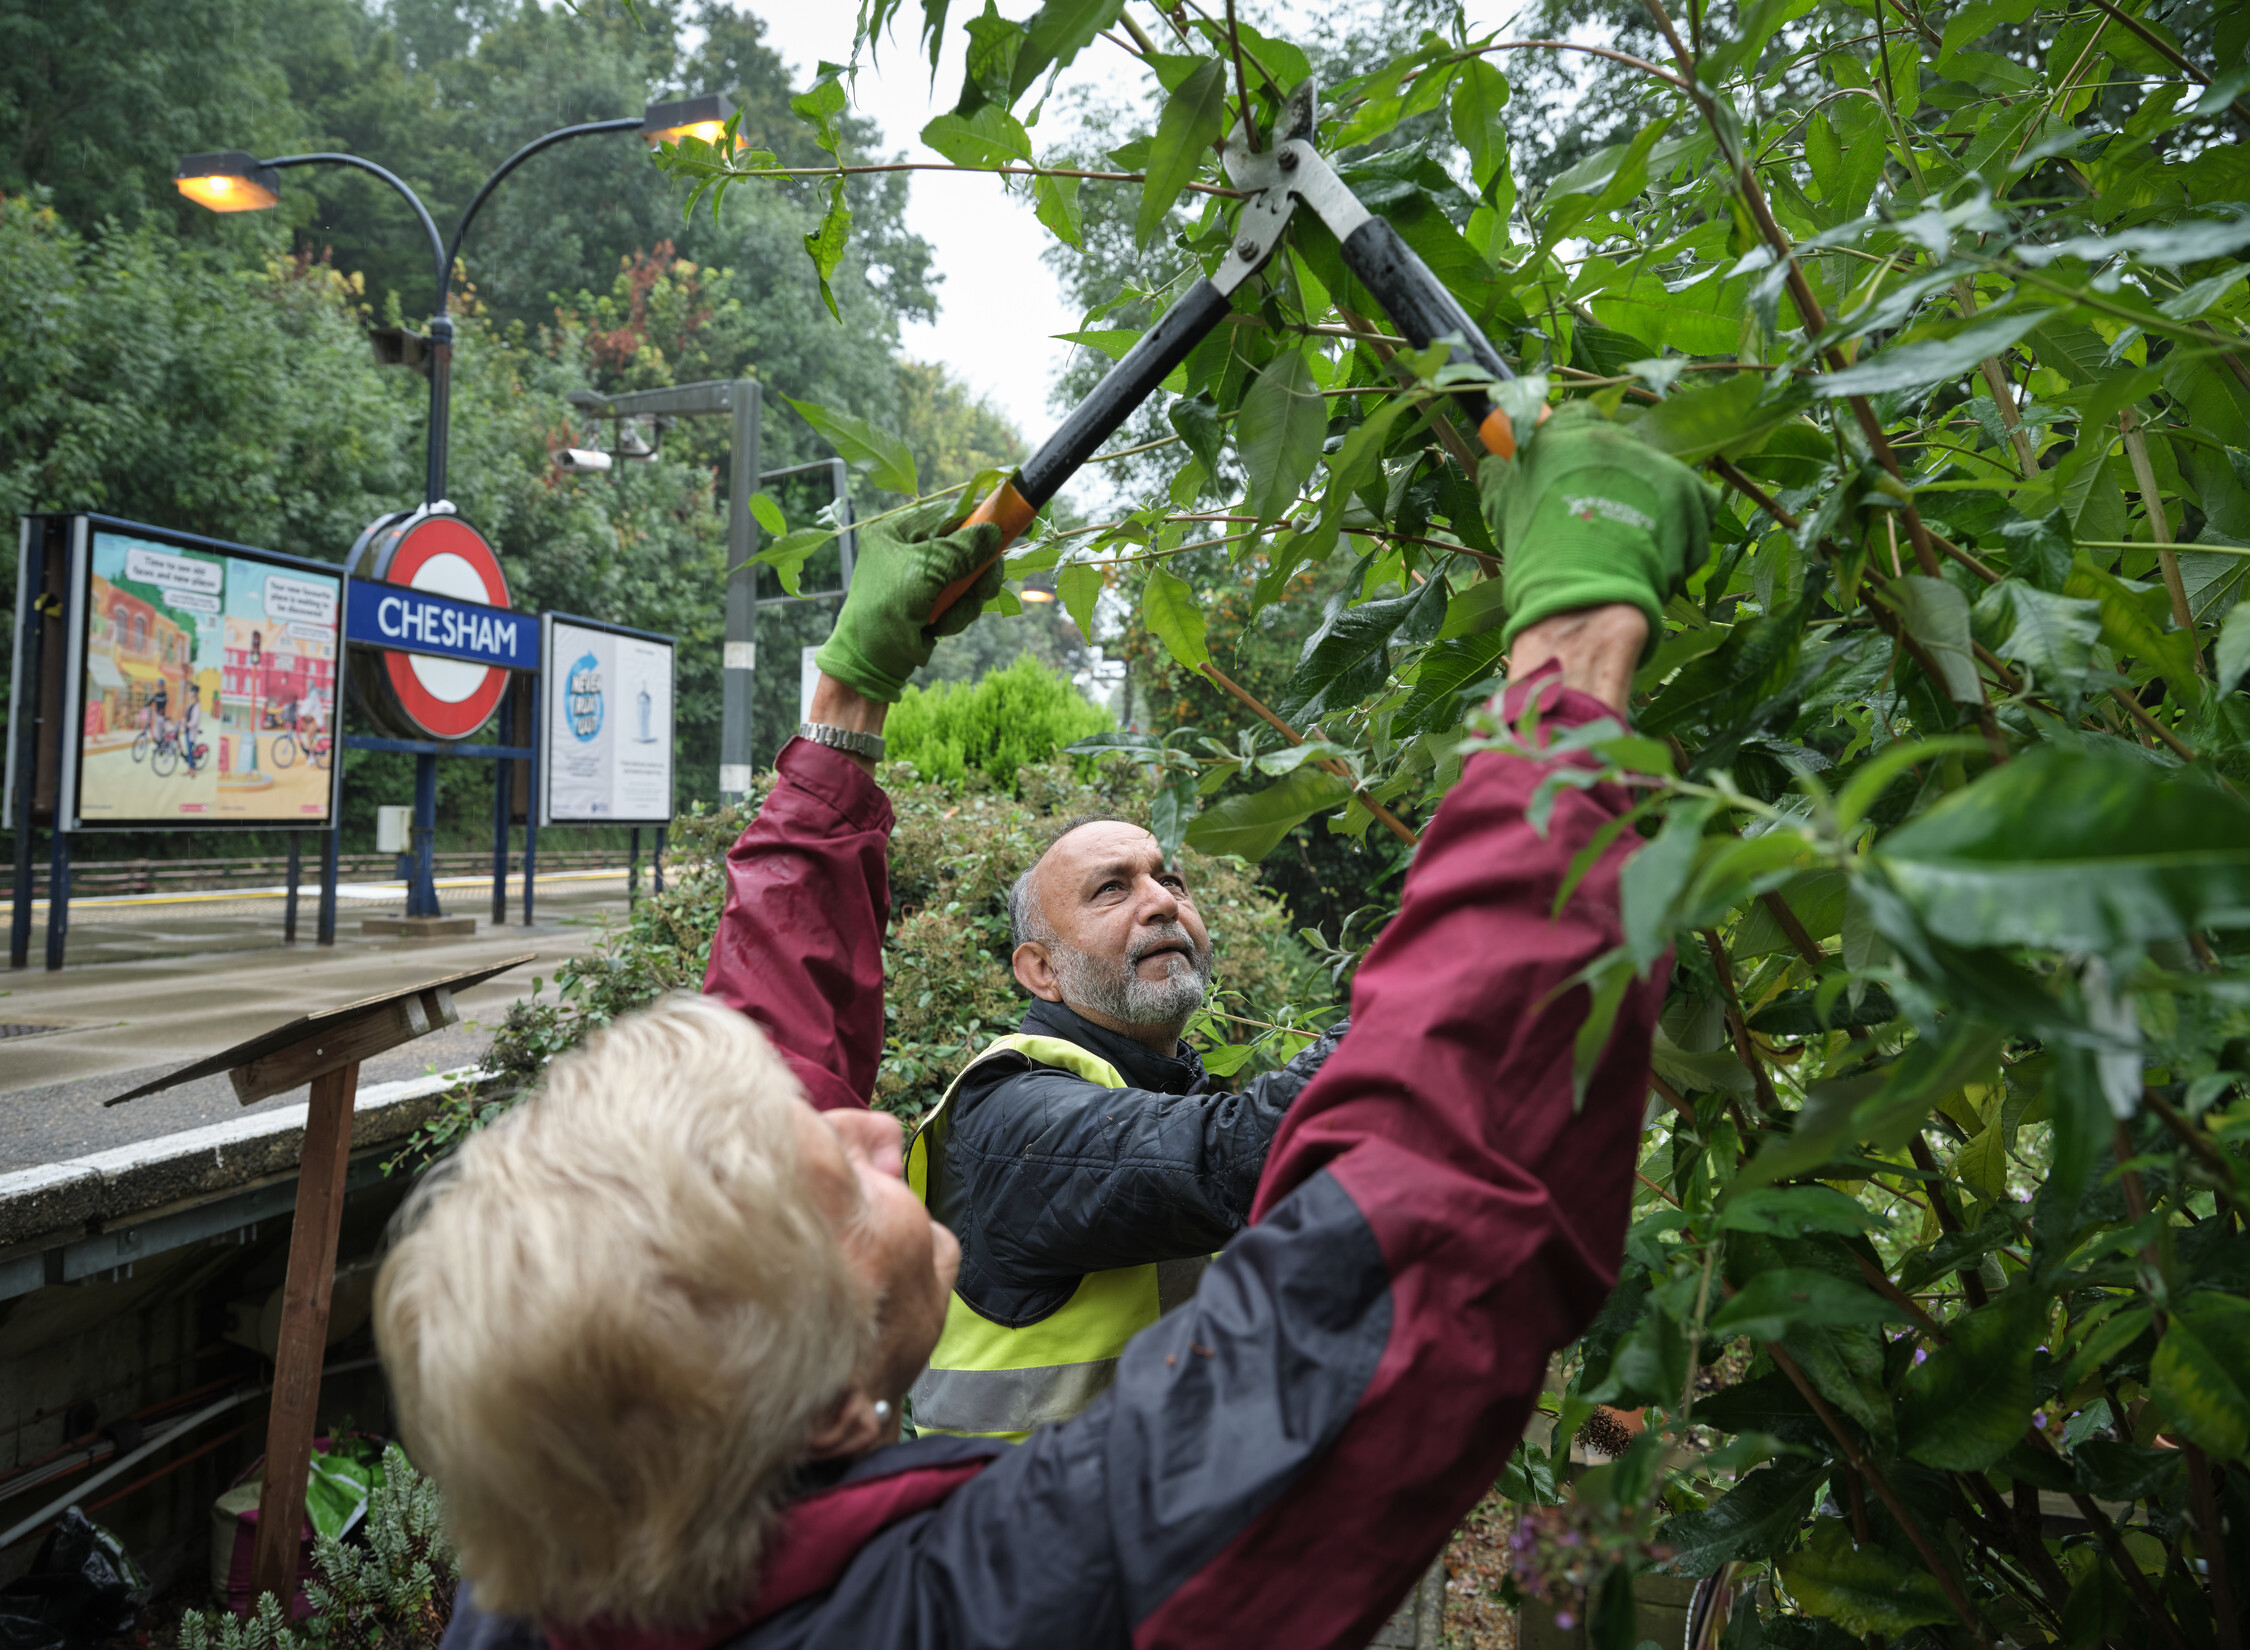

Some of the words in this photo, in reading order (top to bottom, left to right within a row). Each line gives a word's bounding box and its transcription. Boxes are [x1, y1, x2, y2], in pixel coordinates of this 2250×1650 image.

[144, 556, 164, 568] Time
[157, 570, 171, 580] and
[174, 574, 189, 583] new
[287, 585, 301, 594] new
[377, 596, 517, 658] CHESHAM
